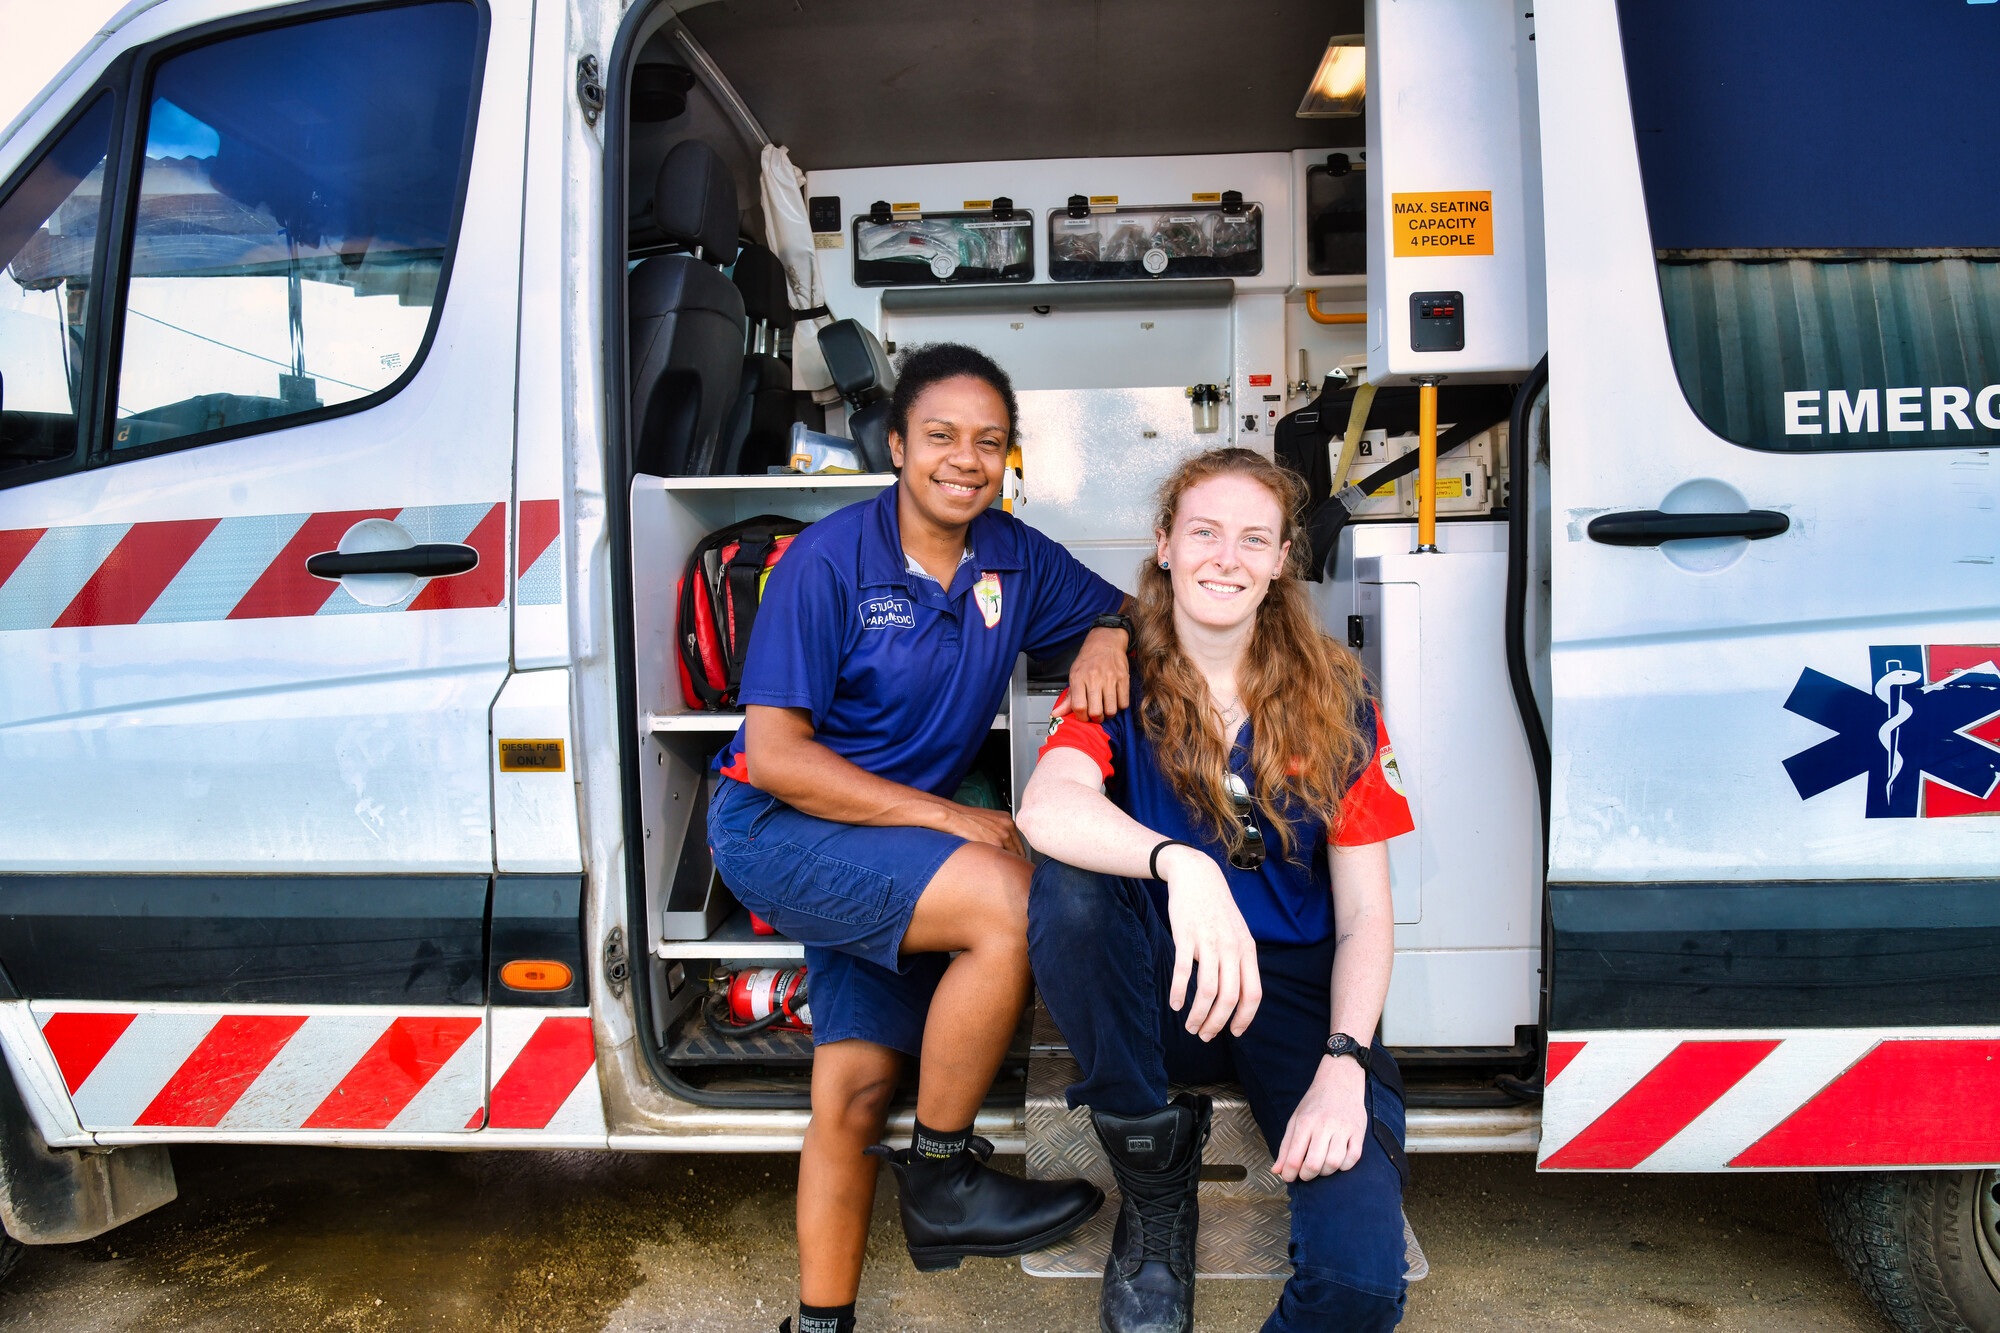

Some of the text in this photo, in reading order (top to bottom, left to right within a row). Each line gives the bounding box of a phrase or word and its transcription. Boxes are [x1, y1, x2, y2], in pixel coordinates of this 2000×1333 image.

[1394, 201, 1490, 214] MAX. SEATING
[1408, 218, 1477, 230] CAPACITY
[1410, 235, 1476, 246] 4 PEOPLE
[1361, 442, 1370, 455] 2
[502, 743, 561, 752] DIESEL FUEL
[516, 756, 547, 766] ONLY
[920, 1137, 962, 1150] SAFETY
[800, 1317, 835, 1328] SAFETY
